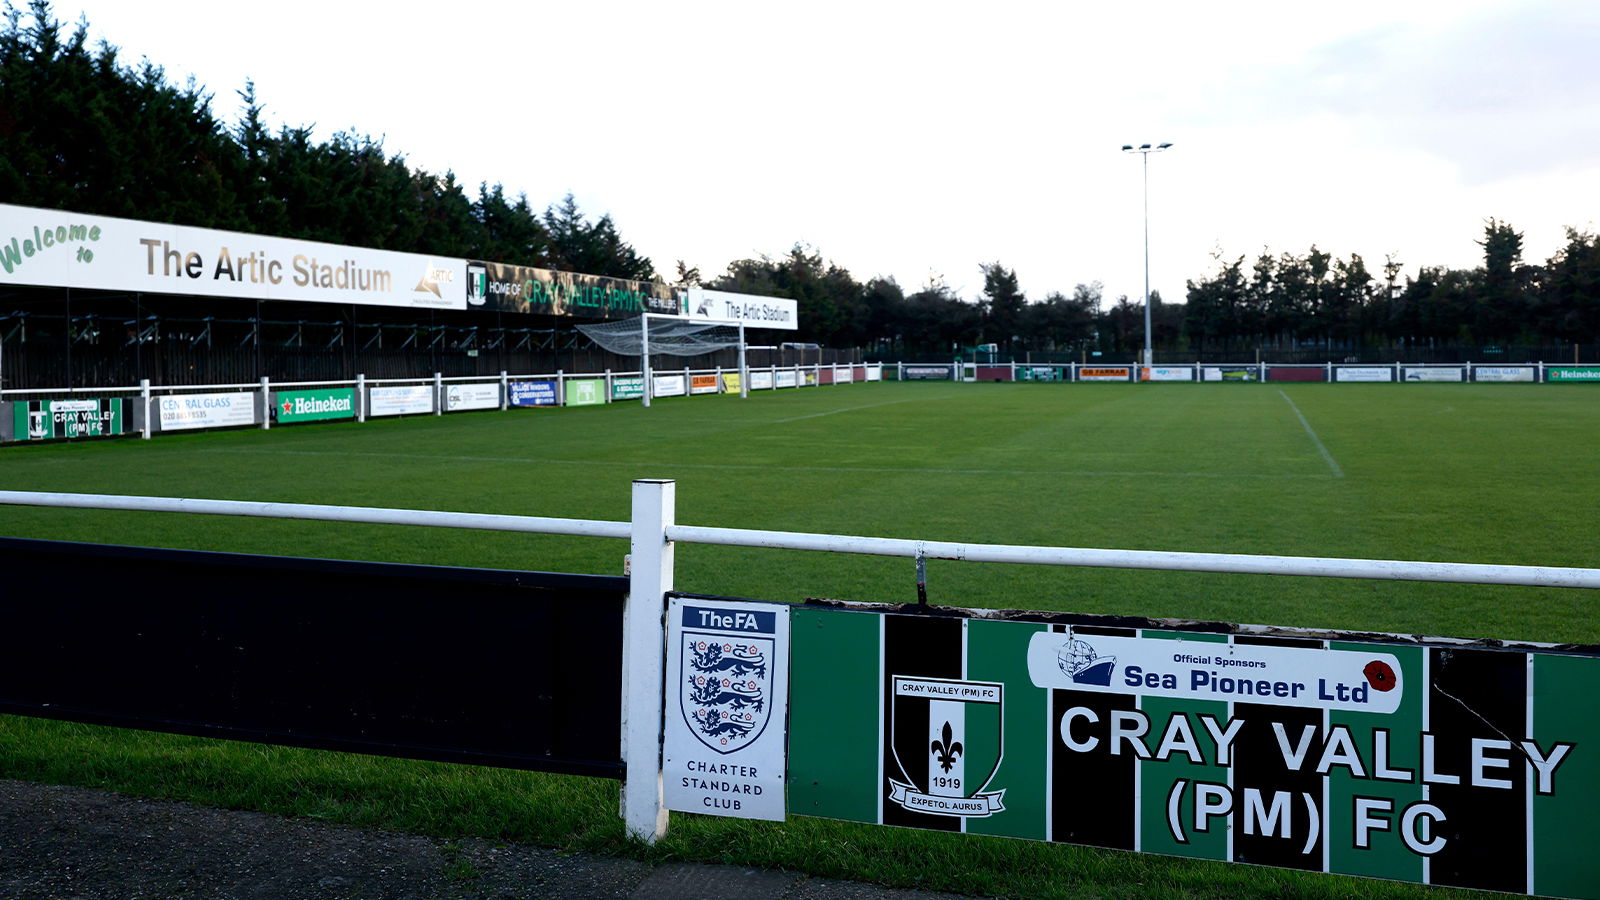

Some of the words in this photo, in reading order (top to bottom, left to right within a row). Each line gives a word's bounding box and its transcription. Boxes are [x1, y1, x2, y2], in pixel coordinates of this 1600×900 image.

[0, 224, 101, 274] Welcome
[76, 246, 94, 264] to
[140, 238, 203, 279] The
[213, 246, 284, 285] Artic
[293, 254, 392, 293] Stadium
[431, 269, 453, 283] ARTIC
[489, 281, 510, 296] HOME
[511, 283, 522, 296] OF
[524, 279, 559, 304] CRAY
[564, 284, 606, 308] VALLEY
[609, 288, 633, 312] (PM)
[634, 292, 649, 312] FC
[725, 301, 741, 318] The
[743, 303, 761, 320] Artic
[763, 304, 790, 322] Stadium
[1560, 370, 1600, 379] Heineke
[163, 399, 201, 411] CENRAL
[203, 398, 231, 409] GLASS
[295, 394, 351, 415] Heineken
[54, 411, 79, 423] CRAY
[81, 411, 115, 421] VALLEY
[163, 412, 175, 420] 020
[69, 423, 89, 434] (PM)
[91, 422, 103, 431] FC
[1173, 653, 1212, 666] Official
[1214, 656, 1266, 670] Sponsors
[902, 683, 926, 693] CRAY
[927, 686, 959, 697] VALLEY
[961, 688, 980, 699] (PM)
[982, 689, 994, 698] FC
[1124, 665, 1178, 690] Sea
[1190, 672, 1305, 699] Pioneer
[1318, 678, 1369, 704] Ltd
[1060, 706, 1245, 766] CRAY
[1272, 722, 1572, 794] VALLEY
[687, 759, 758, 778] CHARTER
[682, 777, 763, 796] STANDARD
[932, 777, 961, 790] 1919
[703, 796, 742, 811] CLUB
[911, 797, 950, 809] EXPETOL
[952, 801, 983, 811] AURUS
[1168, 780, 1320, 855] (PM)
[1355, 798, 1448, 855] FC
